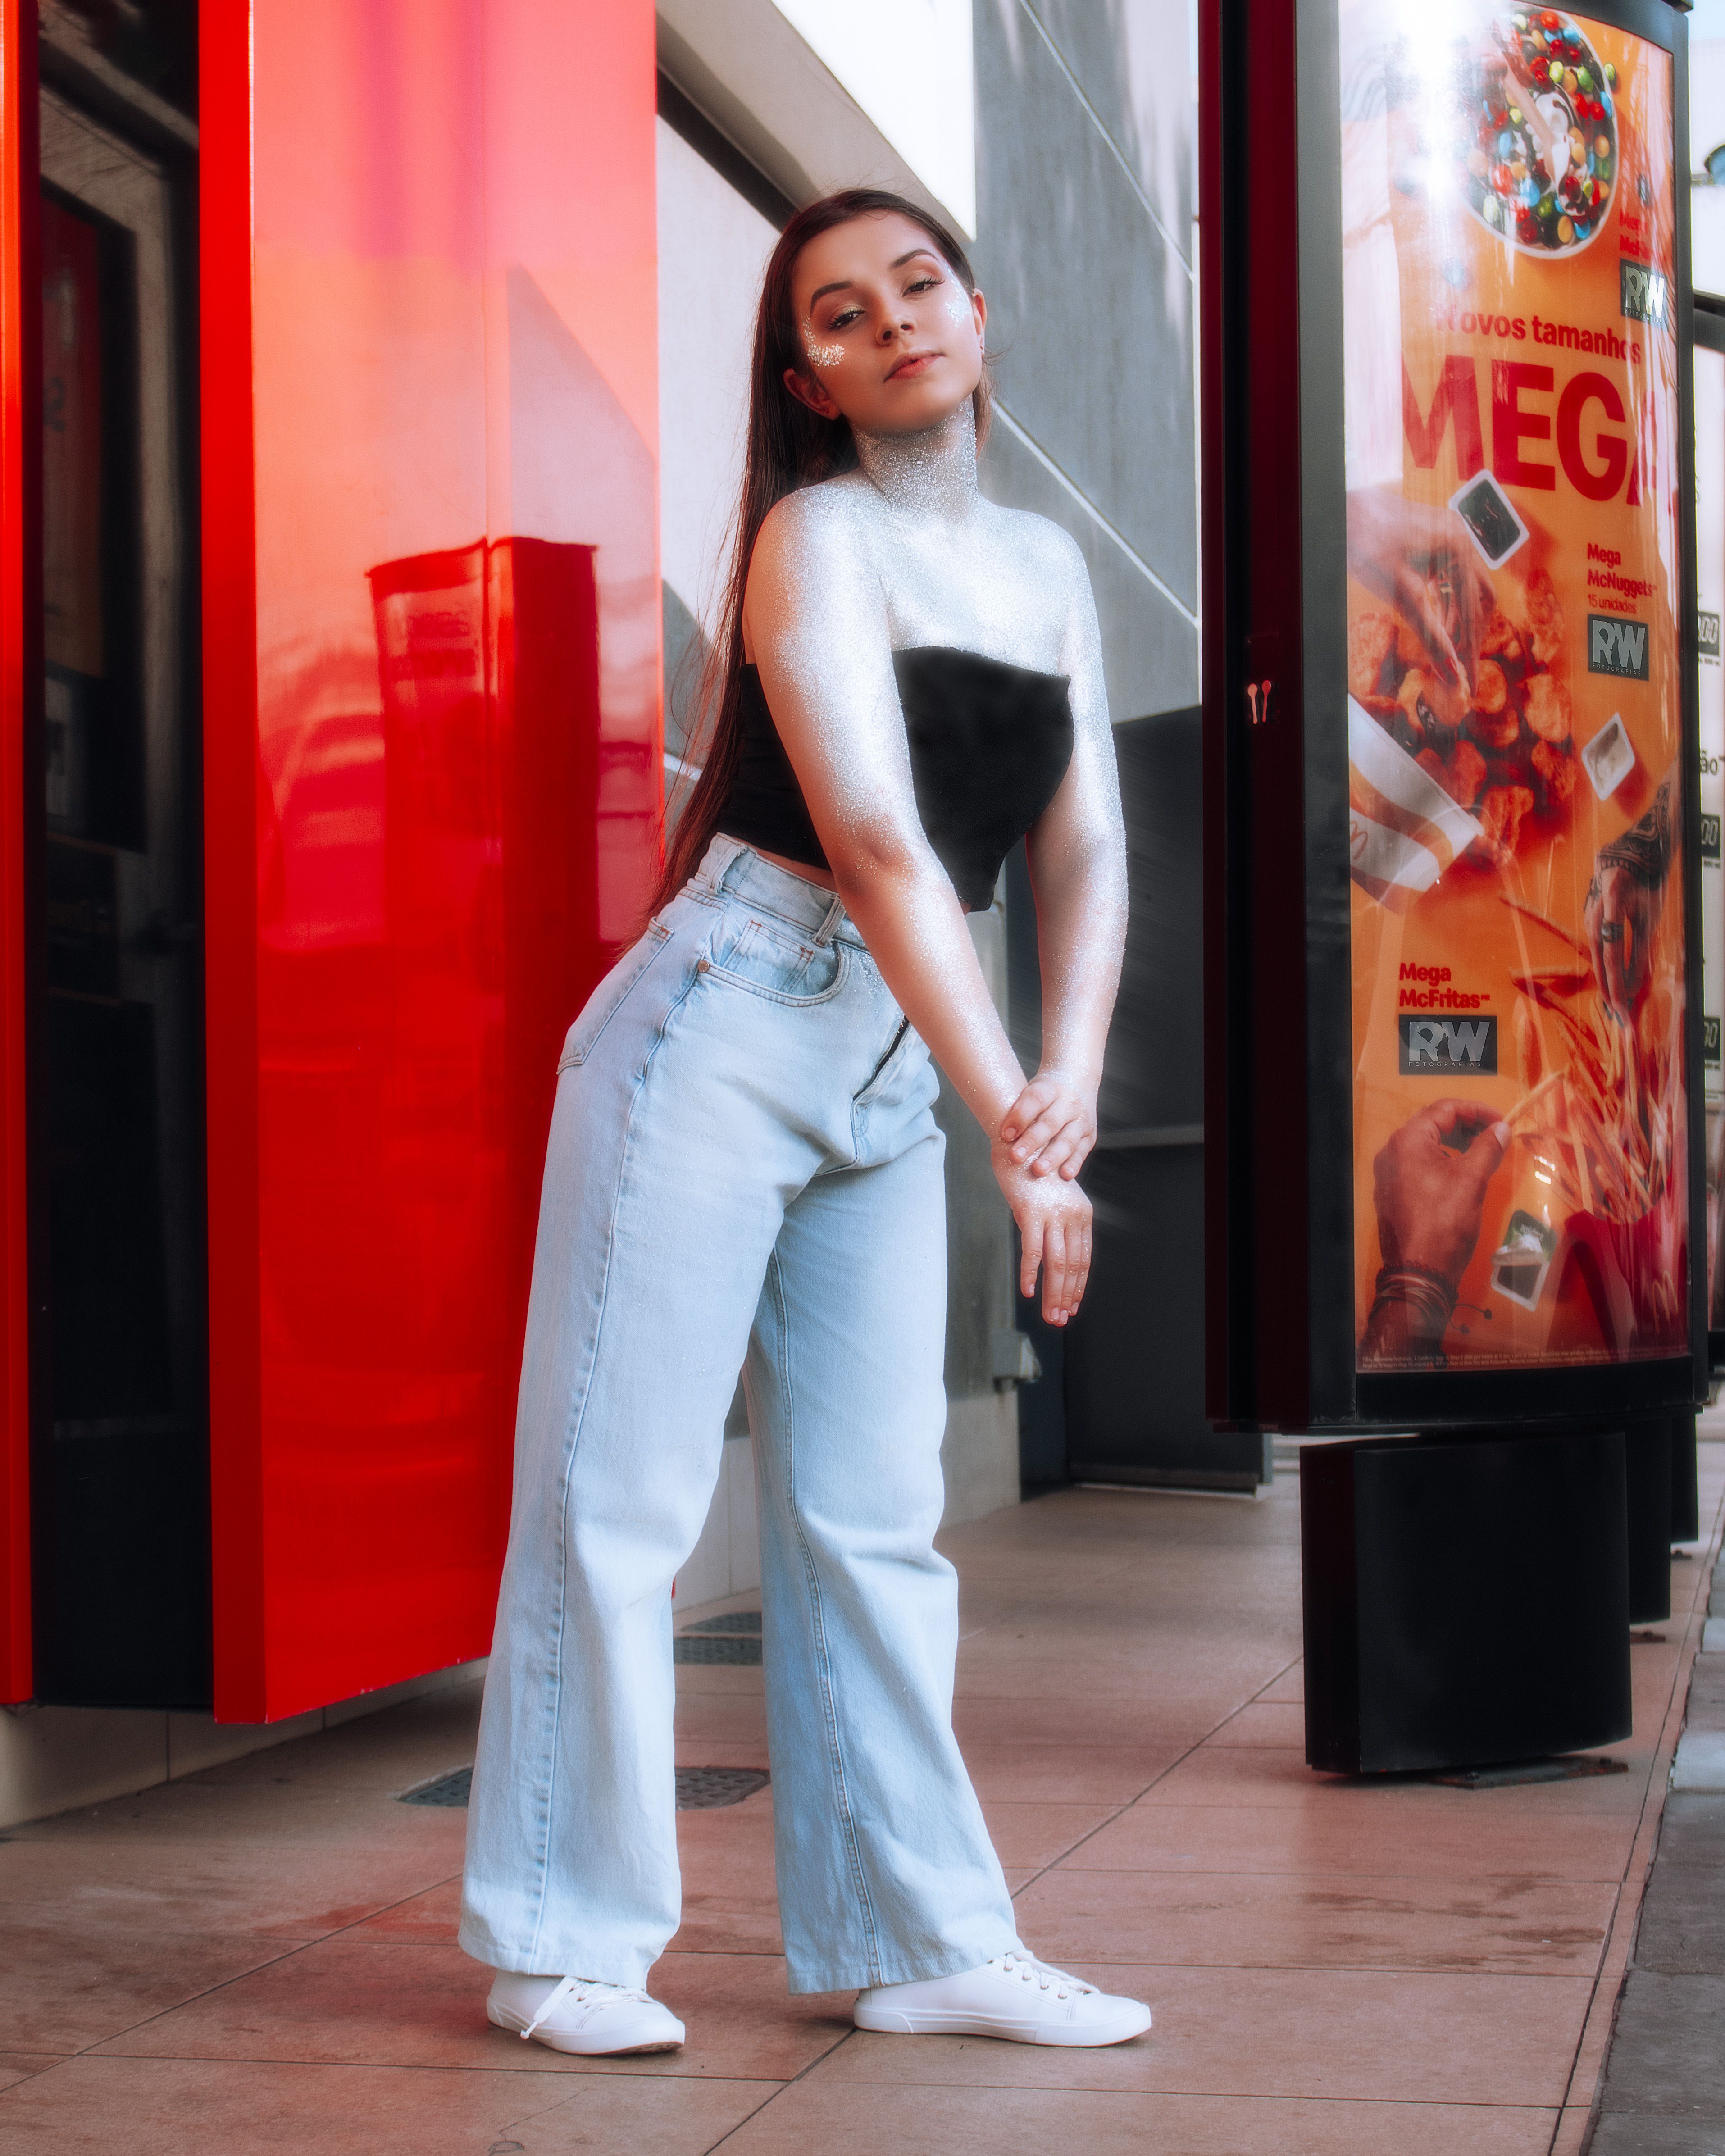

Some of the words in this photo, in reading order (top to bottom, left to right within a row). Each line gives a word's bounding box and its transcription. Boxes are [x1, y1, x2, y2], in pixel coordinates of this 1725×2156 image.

[1436, 304, 1526, 340] Novos
[1532, 315, 1641, 364] tamanhos
[1588, 543, 1621, 568] Mega
[1588, 594, 1598, 608] 15
[1599, 597, 1637, 614] unidades
[1399, 963, 1451, 987] Mega
